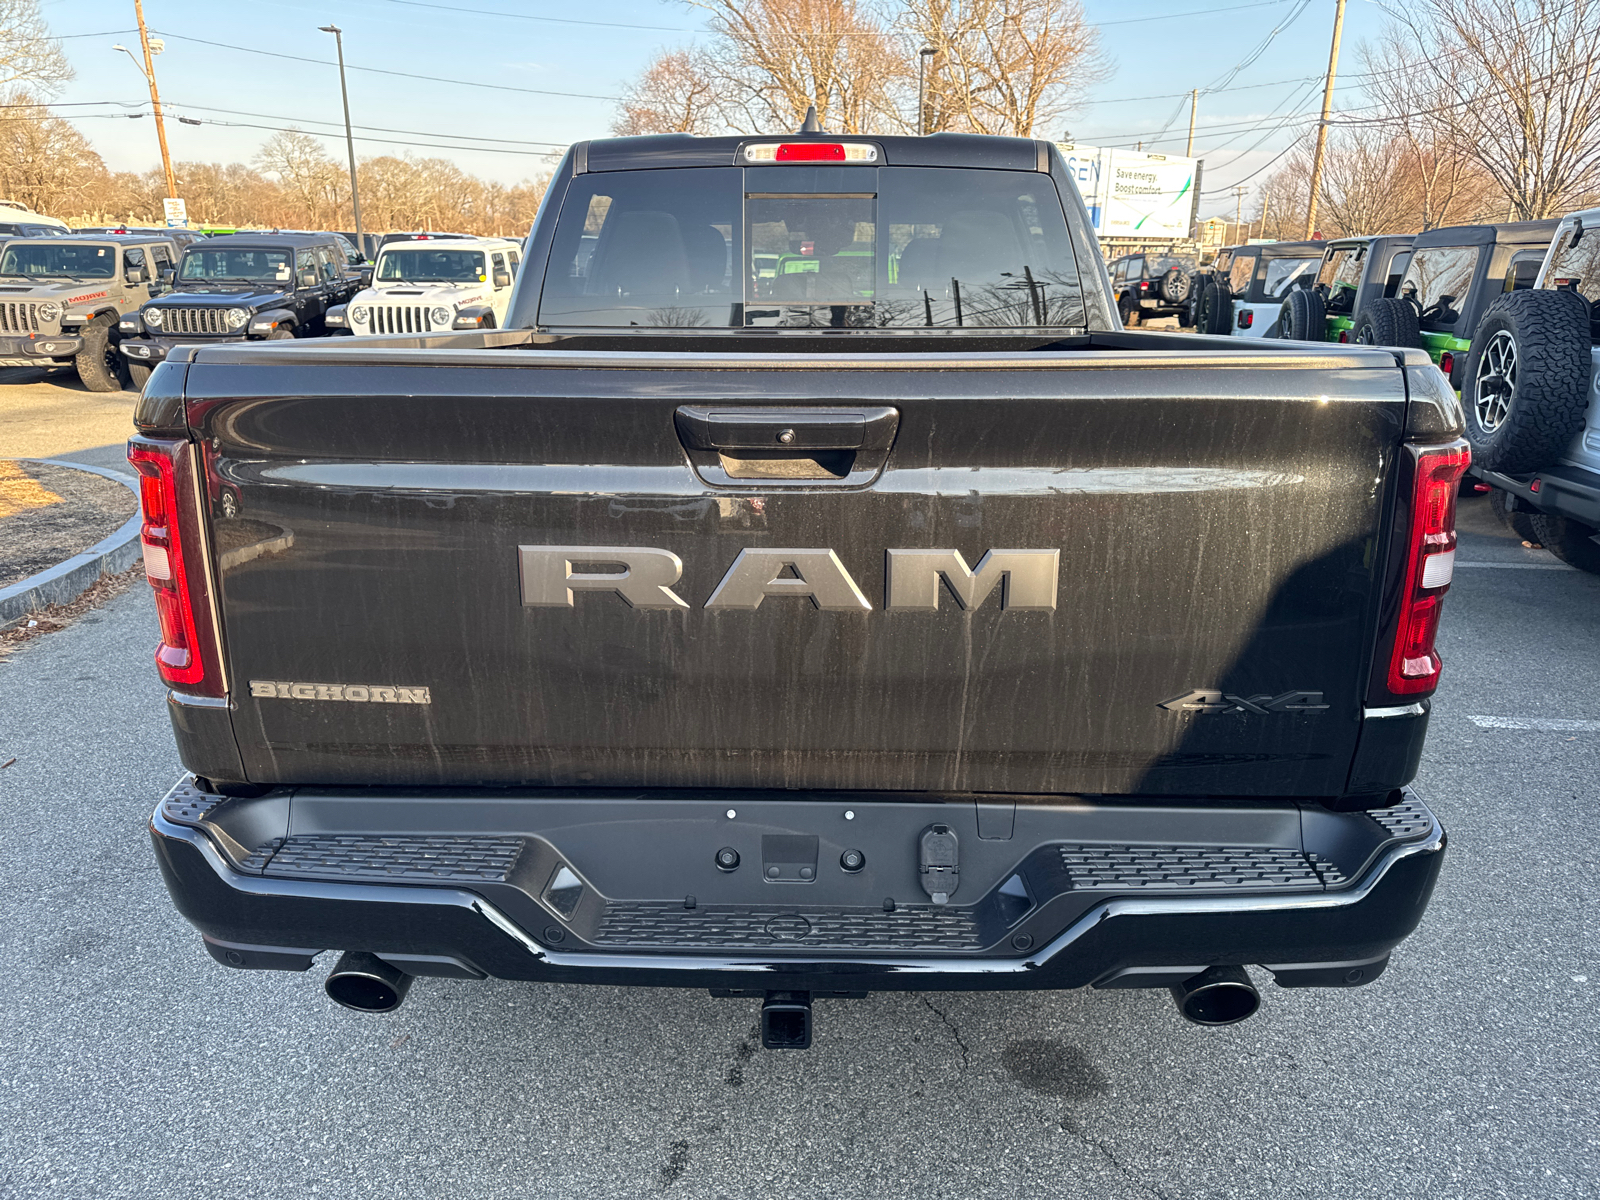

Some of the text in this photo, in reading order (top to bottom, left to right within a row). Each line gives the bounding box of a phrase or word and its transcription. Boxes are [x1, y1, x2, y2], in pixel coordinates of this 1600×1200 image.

[1068, 156, 1101, 182] SEN
[1116, 168, 1158, 183] Save energy.
[1115, 183, 1162, 195] Boost comfort.
[68, 291, 107, 303] MOJAVE
[517, 544, 1061, 612] RAM
[248, 680, 431, 705] BIGHORN
